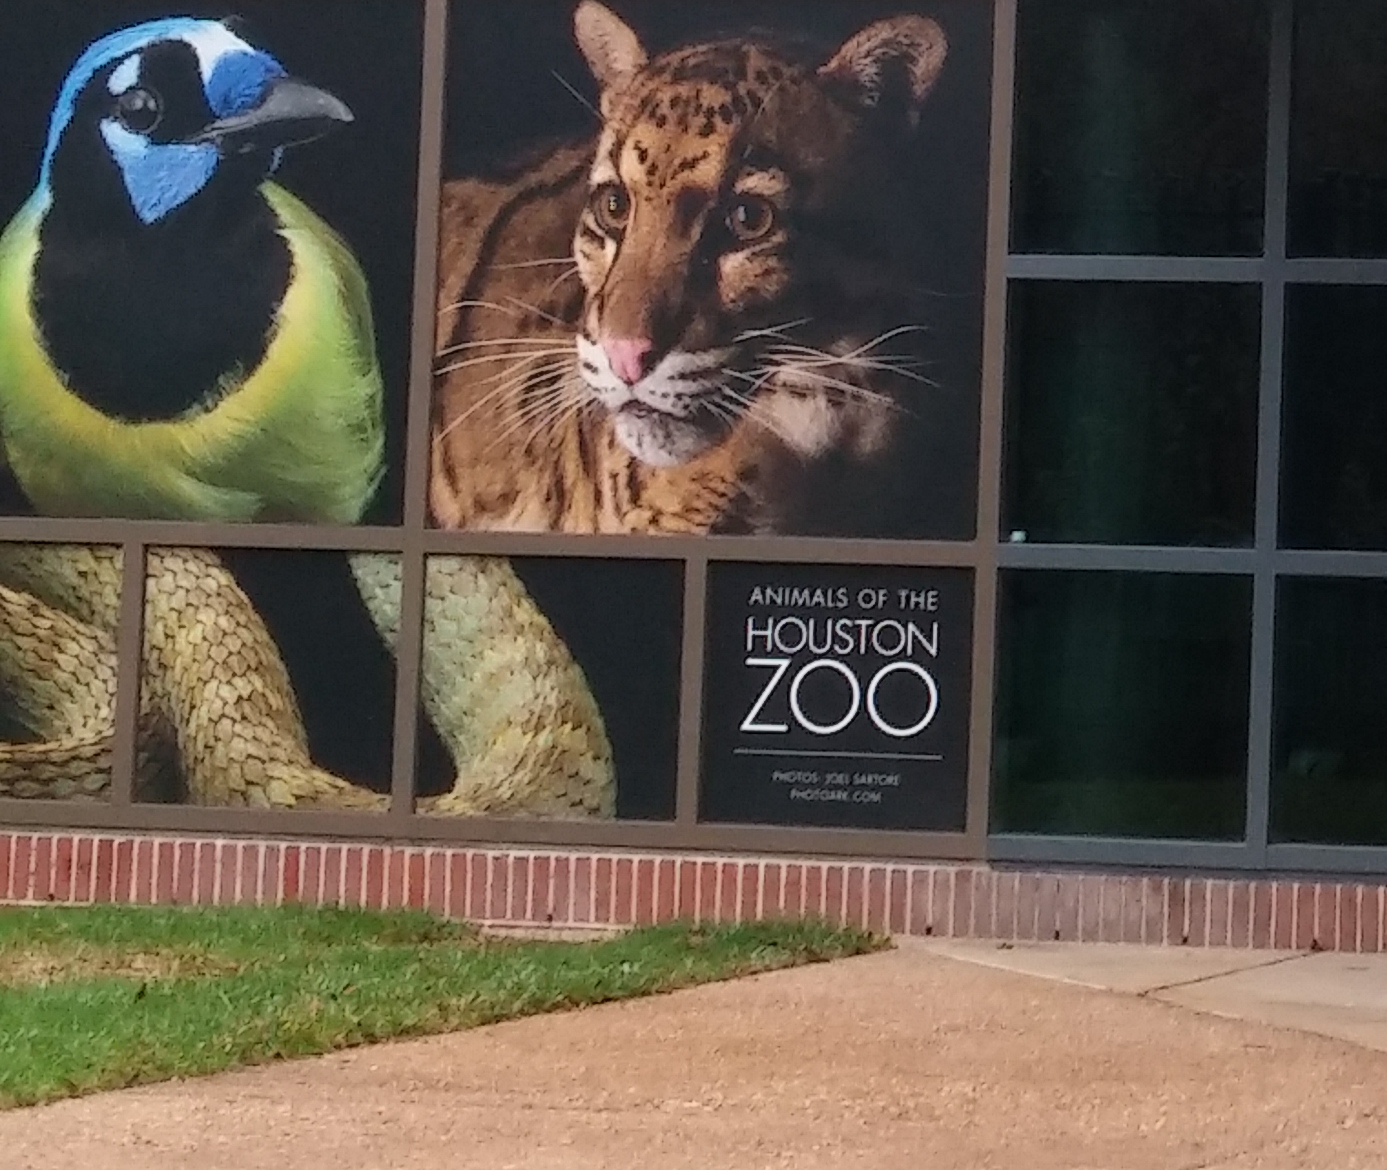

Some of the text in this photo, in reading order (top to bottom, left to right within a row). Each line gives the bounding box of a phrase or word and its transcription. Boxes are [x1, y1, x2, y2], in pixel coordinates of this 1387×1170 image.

[748, 586, 939, 611] ANIMALS OF THE
[746, 616, 938, 658] HOUSTON
[740, 657, 938, 737] ZOO
